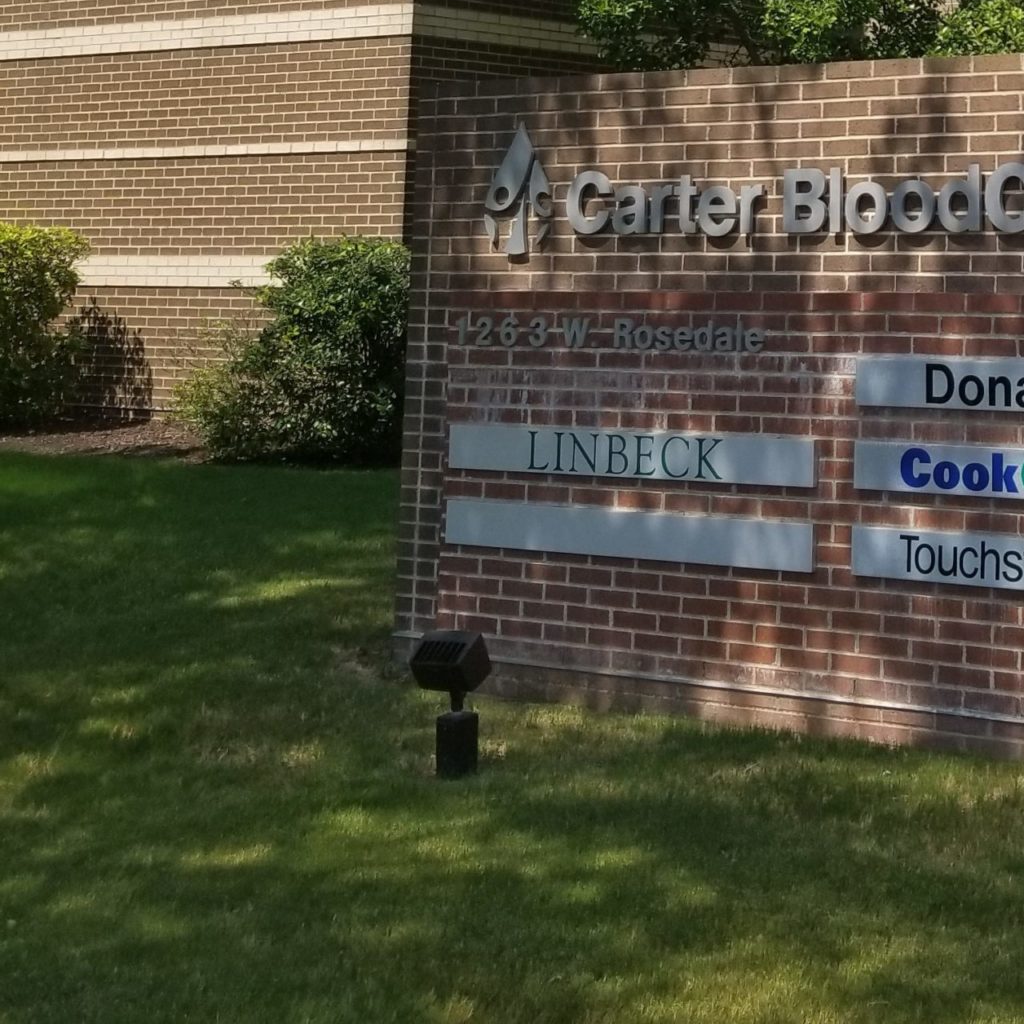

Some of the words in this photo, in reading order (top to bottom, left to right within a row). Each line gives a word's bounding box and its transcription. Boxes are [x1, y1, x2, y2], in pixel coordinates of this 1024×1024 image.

[565, 171, 766, 236] Carter
[455, 316, 548, 348] 1263
[563, 318, 598, 349] W.
[613, 314, 765, 353] Rosedale
[528, 431, 723, 480] LINBECK
